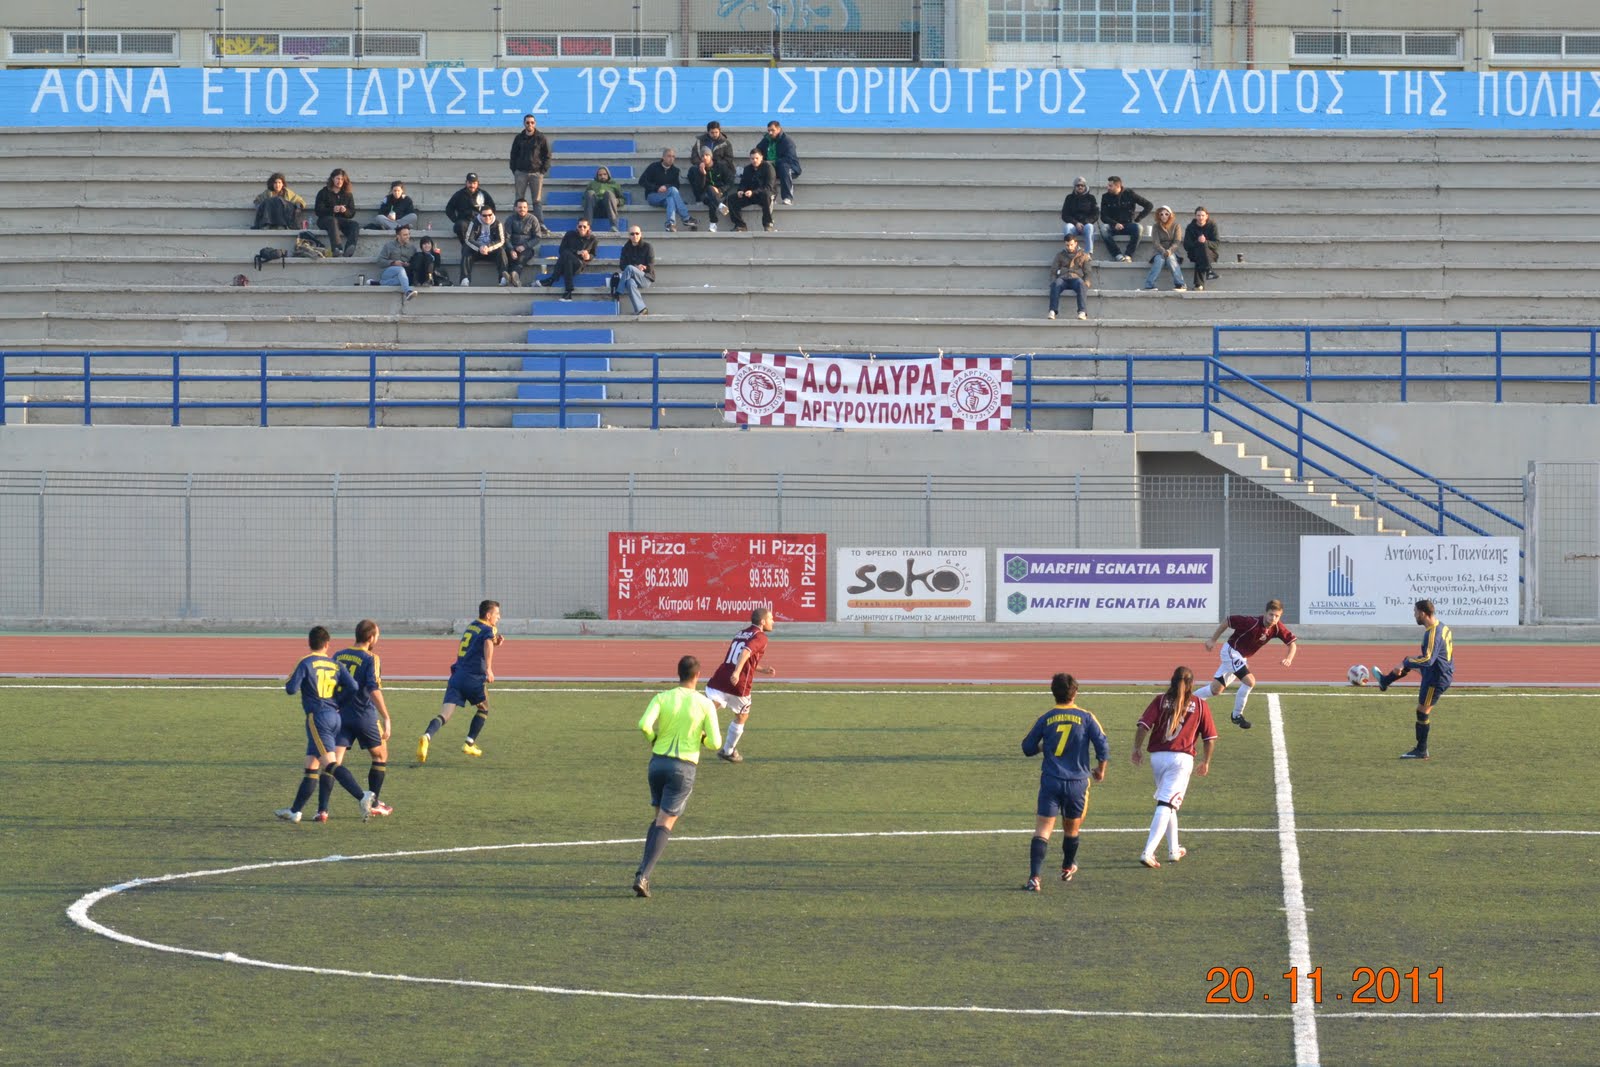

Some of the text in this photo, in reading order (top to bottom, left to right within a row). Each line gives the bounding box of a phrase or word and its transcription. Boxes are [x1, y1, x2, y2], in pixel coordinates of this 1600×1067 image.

[203, 68, 320, 115] ΕΤΟΣ
[346, 68, 550, 115] ΙΔΡΥΣΕΩΣ
[577, 67, 678, 113] 1950
[711, 67, 734, 113] Ο
[762, 67, 1087, 113] ΙΣΤΟΡΙΚΟΤΕΡΟΣ
[1121, 69, 1345, 114] ΣΥΛΛΟΓΟΣ
[1378, 71, 1448, 116] ΤΗΣ
[801, 363, 937, 396] Α.Ο. ΛΑΥΡΑ
[801, 400, 936, 425] ΑΡΓΥΡΟΥΠΟΛΗΣ
[619, 539, 686, 555] Hi Pizza
[749, 539, 766, 555] Hi
[772, 540, 816, 556] Pizza
[1384, 544, 1508, 564] Αντώνιος Γ. Τσικνάκης
[645, 567, 689, 587] 96.23.300
[750, 568, 789, 588] 99.35.536
[1030, 563, 1208, 575] MARFIN EGNATIA BANK
[1457, 574, 1475, 583] 162,
[658, 596, 694, 613] Κύπρου
[696, 597, 710, 610] 147
[1030, 598, 1208, 609] MARFIN EGNATIA BANK
[458, 632, 473, 657] 2
[1054, 724, 1073, 757] 7
